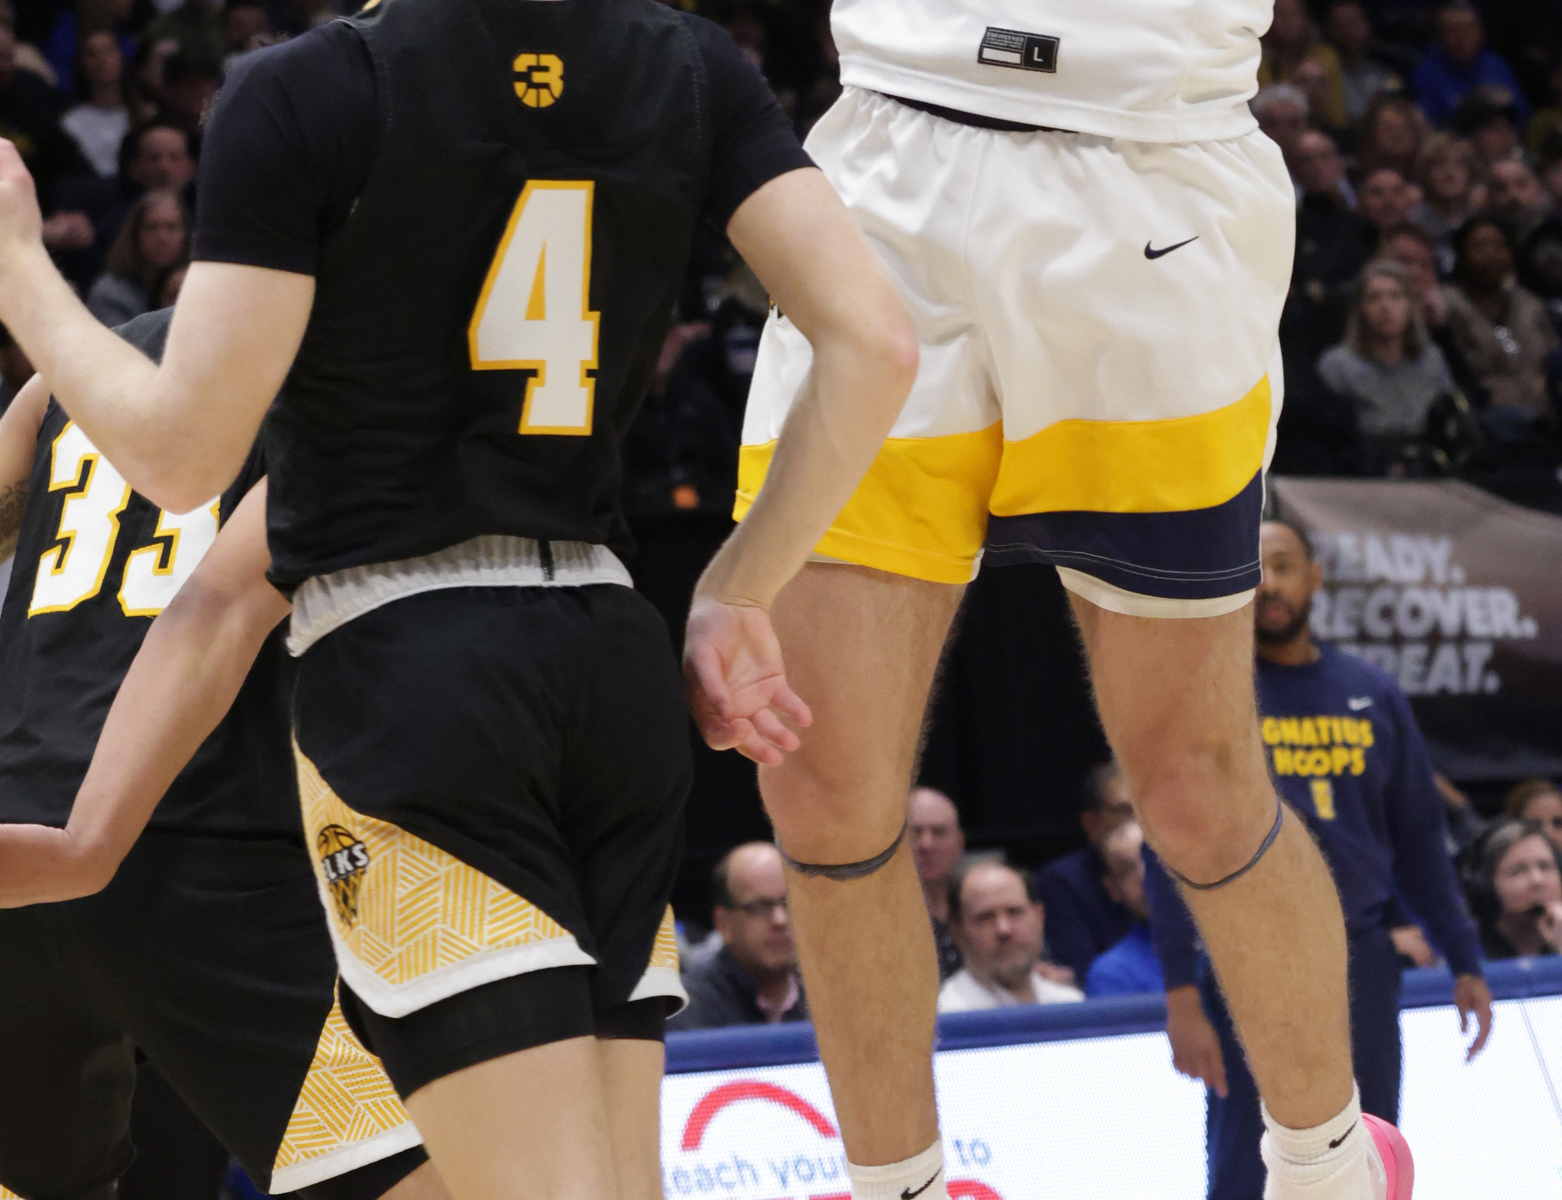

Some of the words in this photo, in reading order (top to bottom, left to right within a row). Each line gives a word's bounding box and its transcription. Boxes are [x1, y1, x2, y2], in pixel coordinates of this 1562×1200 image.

[1033, 46, 1044, 62] L
[513, 52, 564, 108] 3
[468, 179, 601, 436] 4
[28, 419, 221, 619] 33
[1261, 715, 1375, 748] GNATIUS
[1273, 745, 1366, 776] HOOPS
[322, 841, 369, 881] LKS
[662, 1154, 759, 1195] each
[954, 1137, 992, 1167] to
